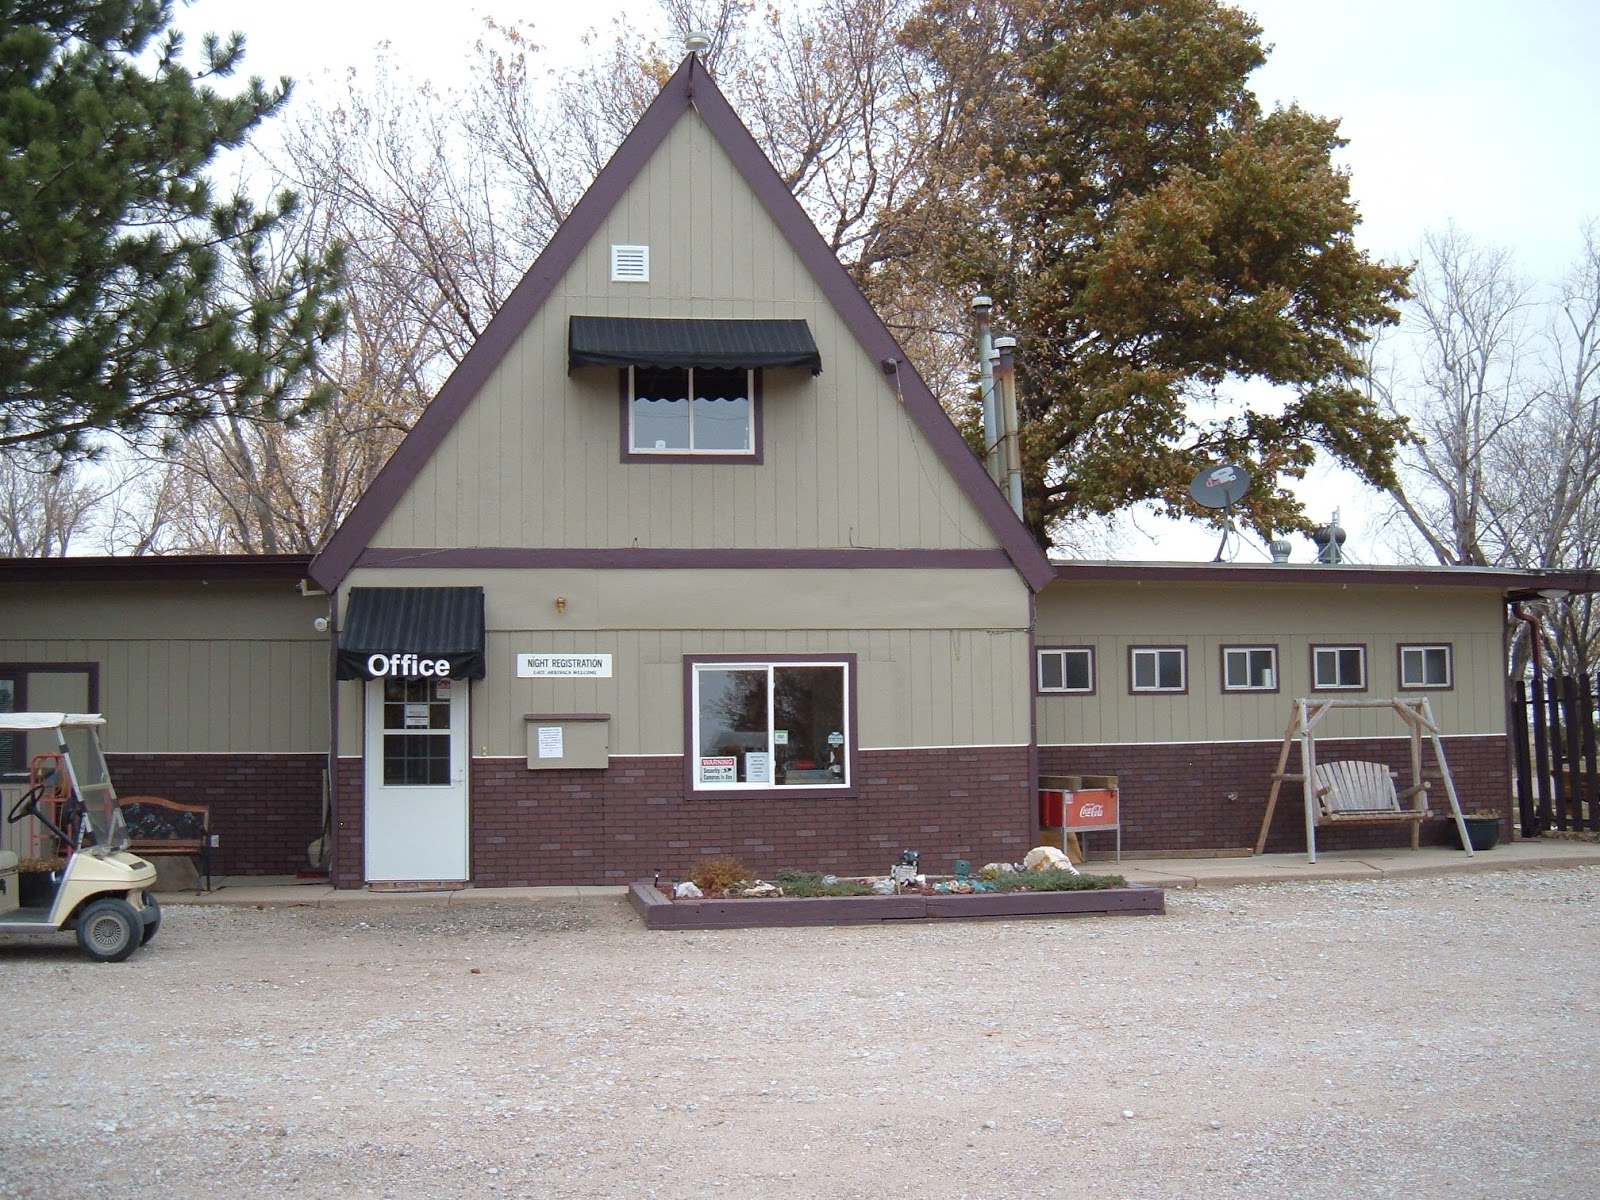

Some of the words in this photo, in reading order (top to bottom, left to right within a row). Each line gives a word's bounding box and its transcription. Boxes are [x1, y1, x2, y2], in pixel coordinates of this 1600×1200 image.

[368, 654, 450, 676] Office
[528, 658, 548, 667] NIGHT
[552, 658, 602, 667] REGISTRATION
